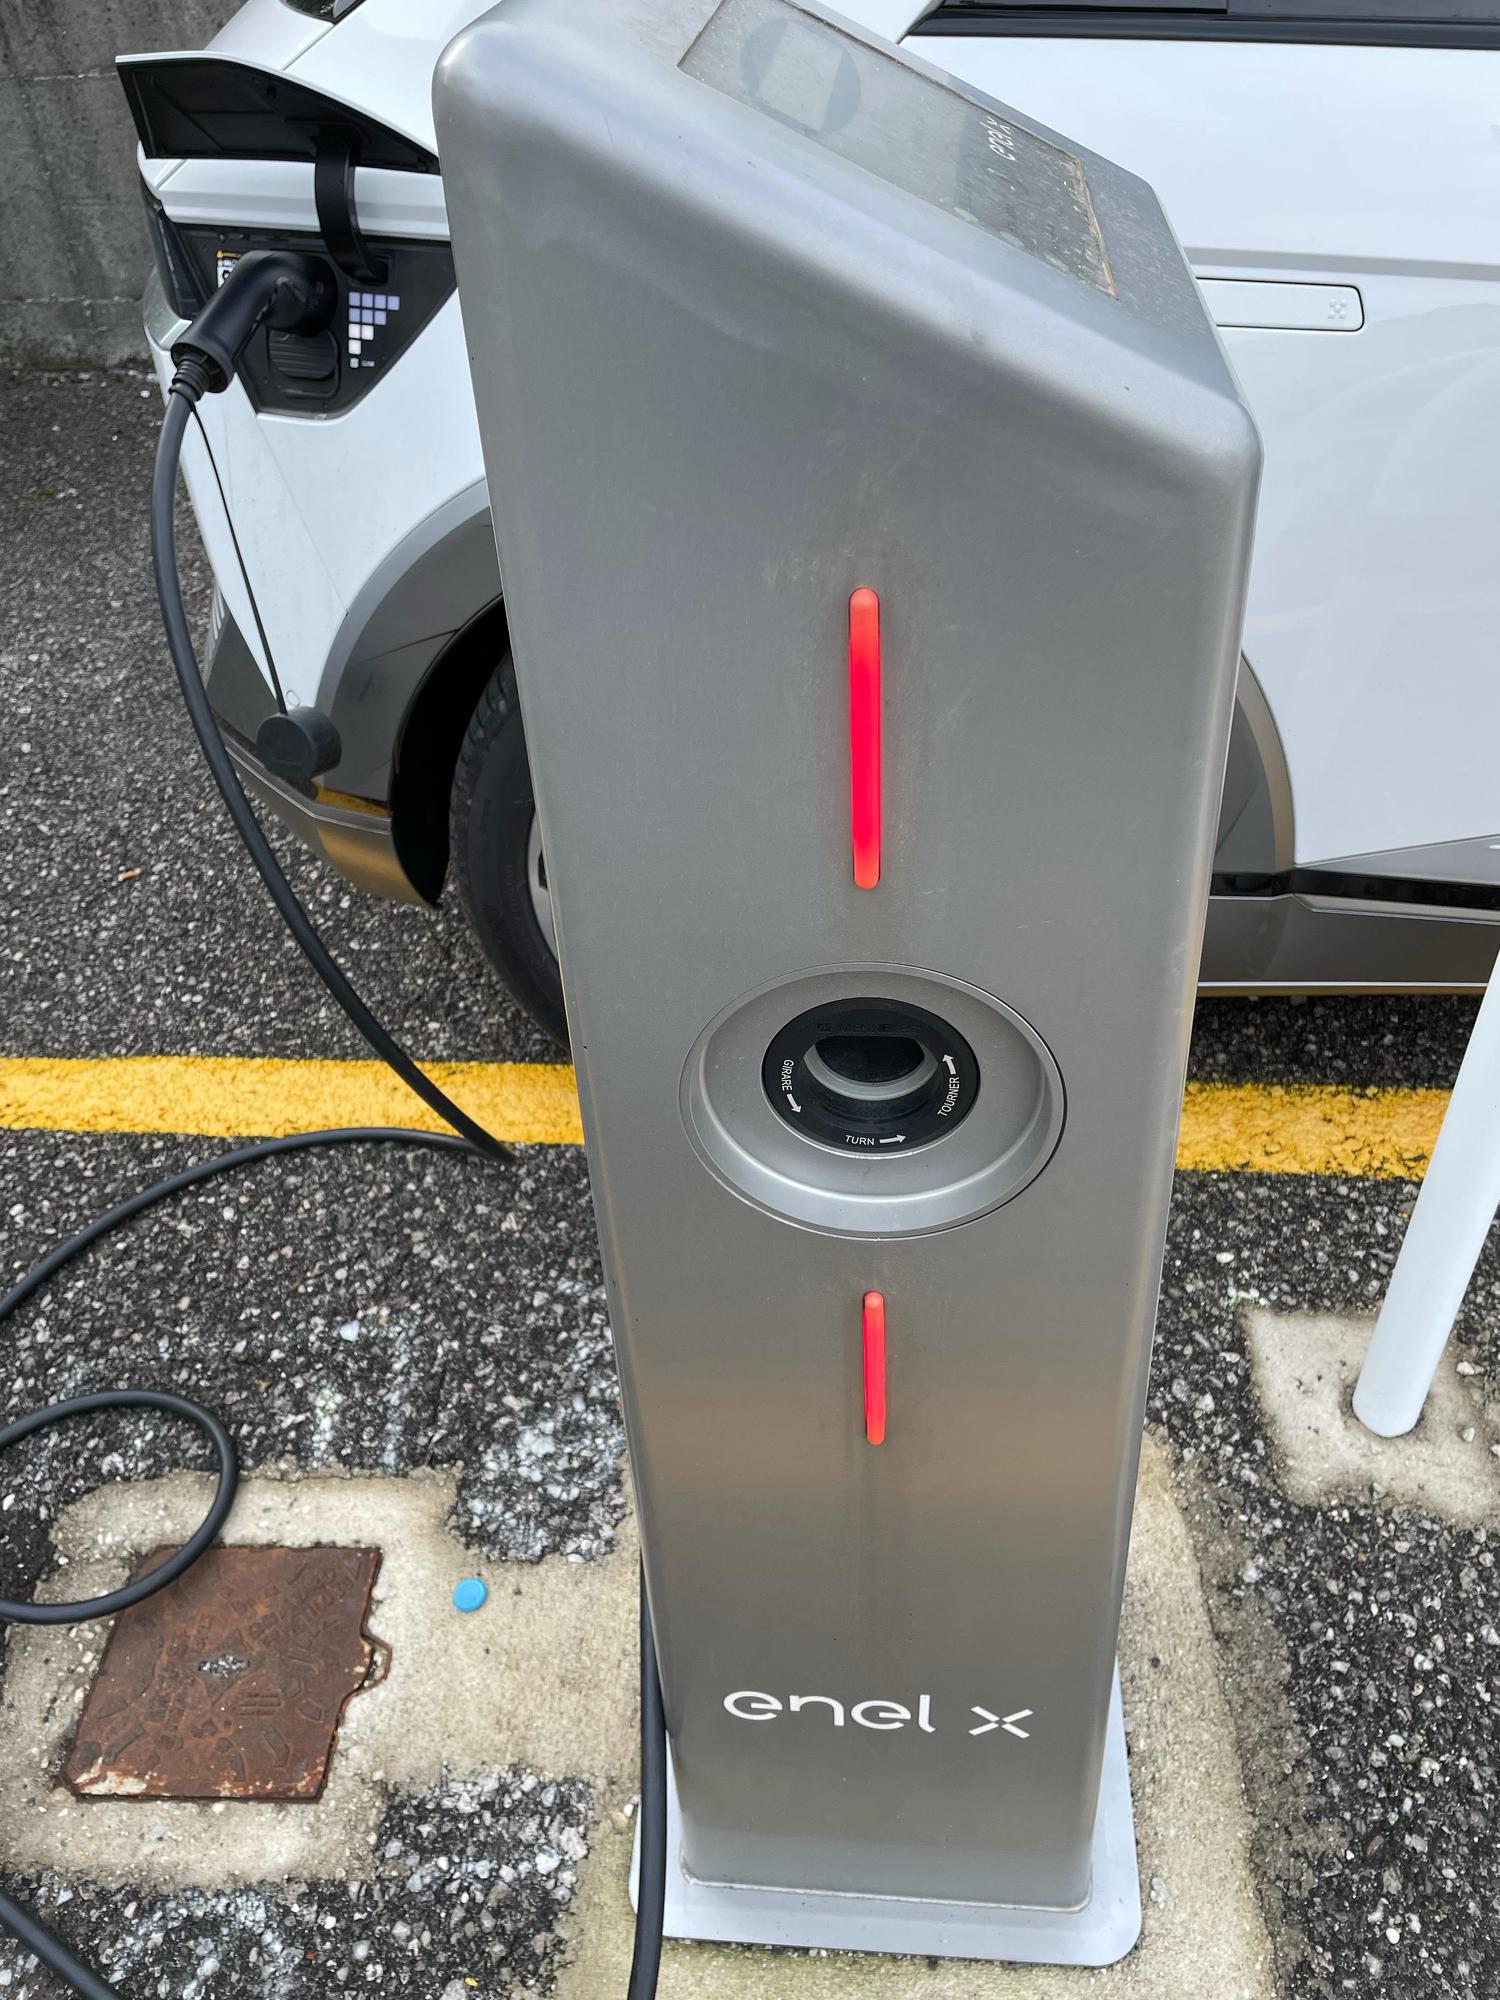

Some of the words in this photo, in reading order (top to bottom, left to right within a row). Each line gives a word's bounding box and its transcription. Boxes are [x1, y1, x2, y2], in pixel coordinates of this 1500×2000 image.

[979, 121, 1016, 161] enel
[780, 1058, 795, 1092] GIRARE
[937, 1076, 960, 1117] TOURNER
[845, 1134, 875, 1146] TURN
[723, 1690, 936, 1733] enel
[968, 1705, 1034, 1739] x
